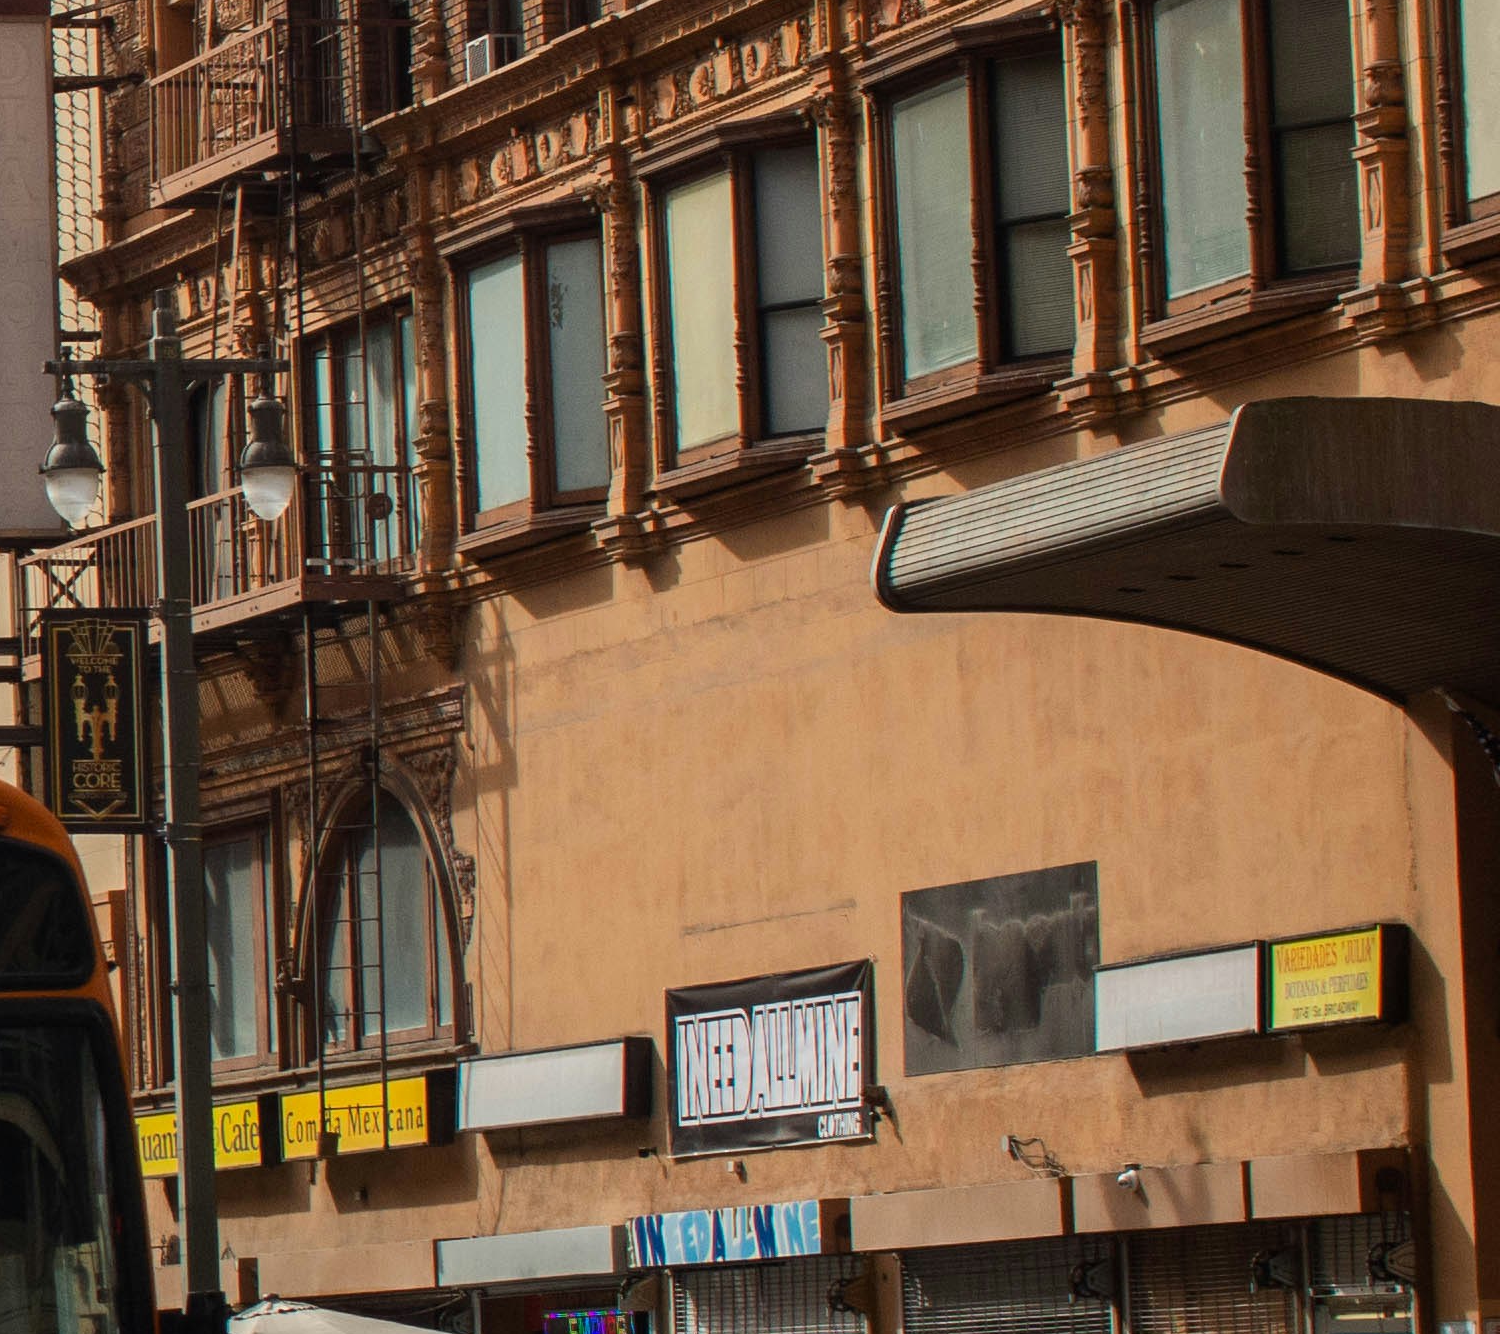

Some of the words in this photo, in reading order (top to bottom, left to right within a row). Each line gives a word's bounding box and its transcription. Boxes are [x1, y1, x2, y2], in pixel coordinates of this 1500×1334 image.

[70, 656, 119, 666] WELCOME
[77, 665, 91, 674] TO
[95, 665, 112, 674] THE
[71, 762, 123, 773] HISTORIC
[71, 772, 123, 789] CORE
[1275, 942, 1338, 974] VARIEDADES
[218, 1110, 261, 1155] Cafe
[817, 1111, 864, 1139] CLOTHING
